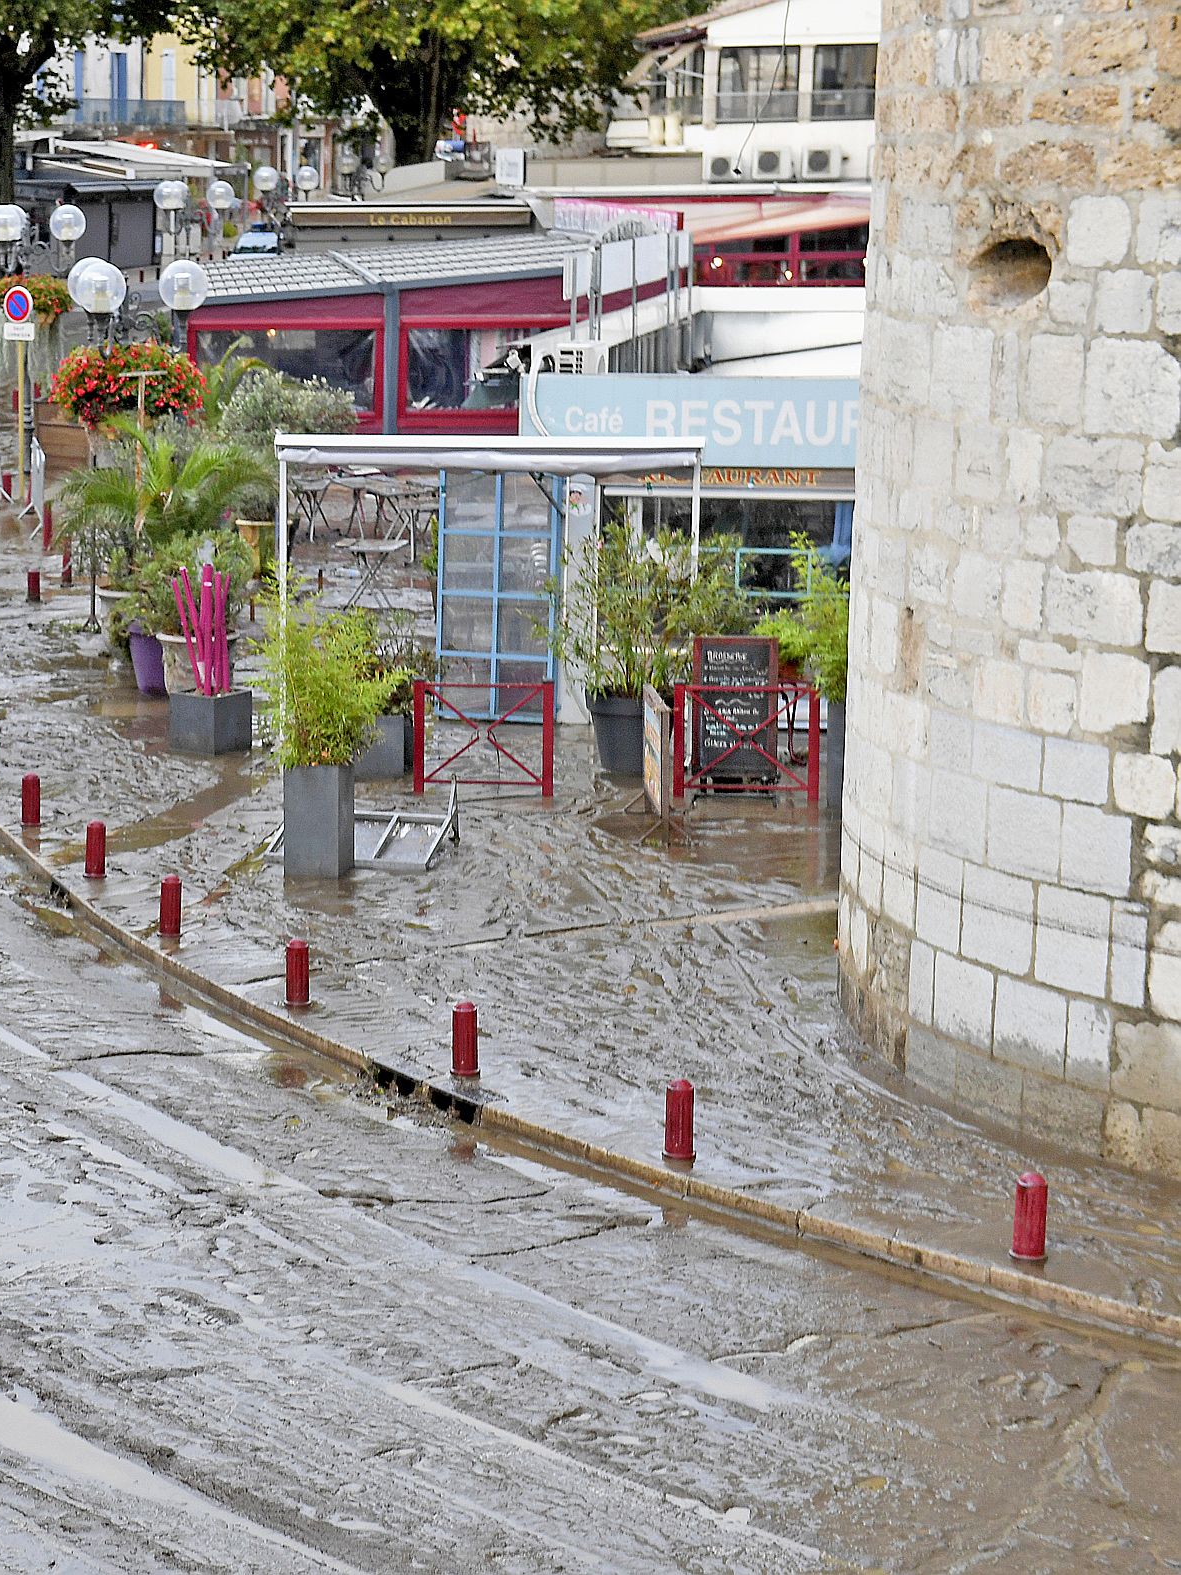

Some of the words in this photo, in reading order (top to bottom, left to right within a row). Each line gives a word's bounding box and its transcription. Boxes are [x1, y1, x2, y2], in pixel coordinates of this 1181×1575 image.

[370, 213, 386, 226] Le
[390, 213, 452, 226] Cabanon
[565, 405, 624, 433] Café
